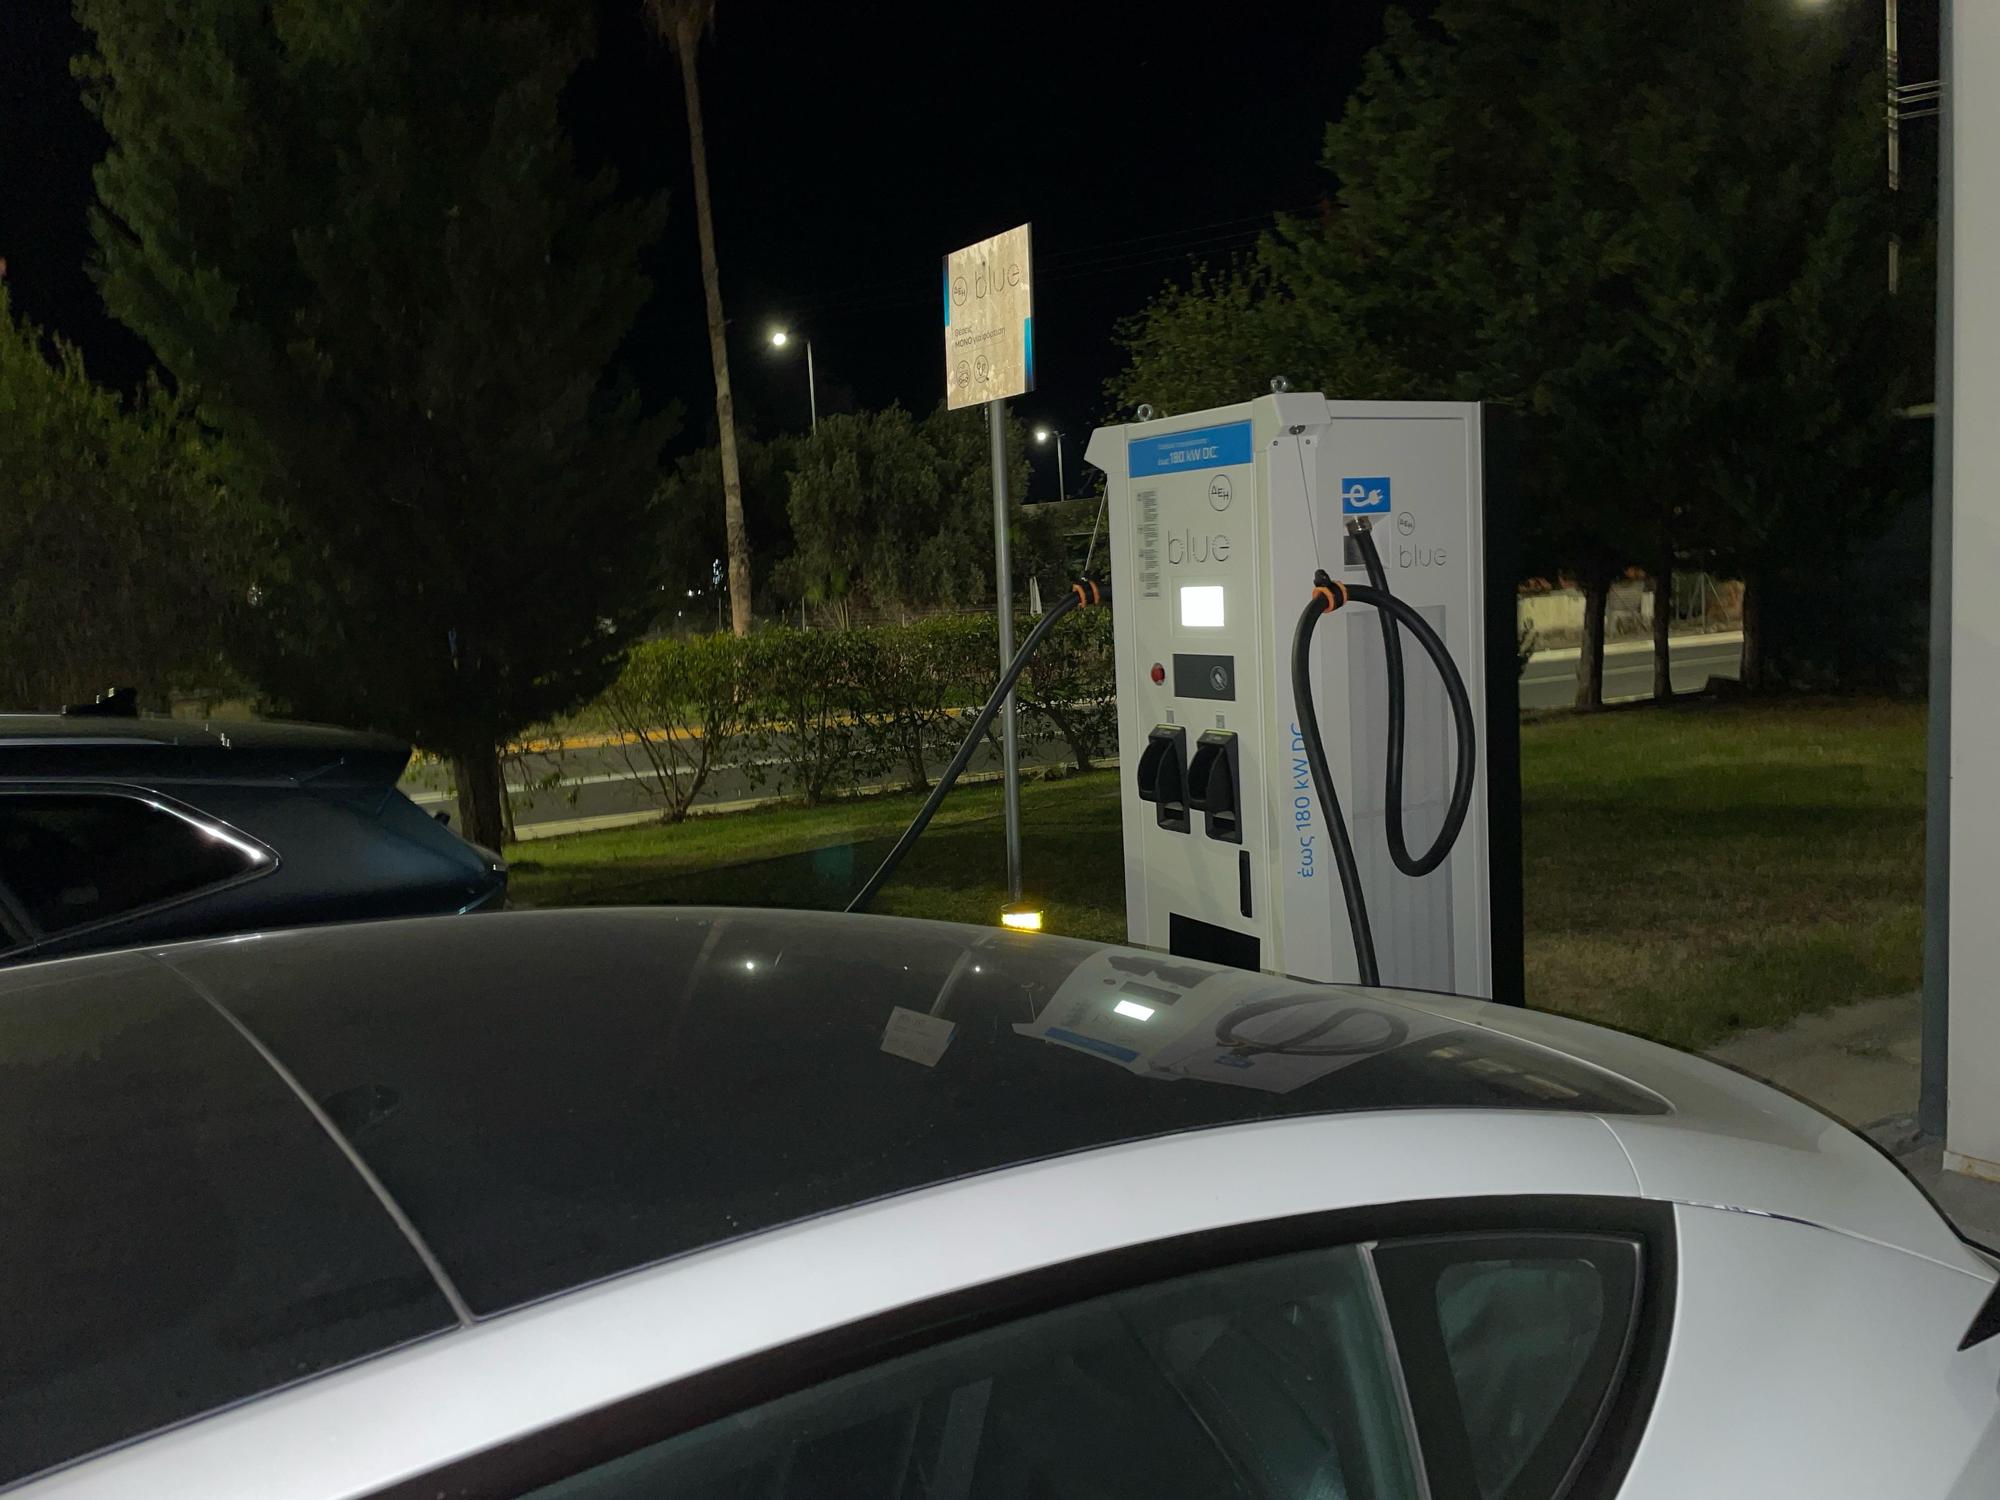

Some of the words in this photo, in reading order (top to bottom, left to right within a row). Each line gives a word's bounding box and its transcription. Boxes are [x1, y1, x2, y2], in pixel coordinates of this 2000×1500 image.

[975, 264, 1019, 298] blue
[1202, 446, 1219, 460] DC
[1168, 528, 1230, 565] blue
[1399, 544, 1447, 569] blue
[1292, 758, 1309, 790] kW
[1295, 796, 1311, 831] 180
[1297, 836, 1315, 878] έως
